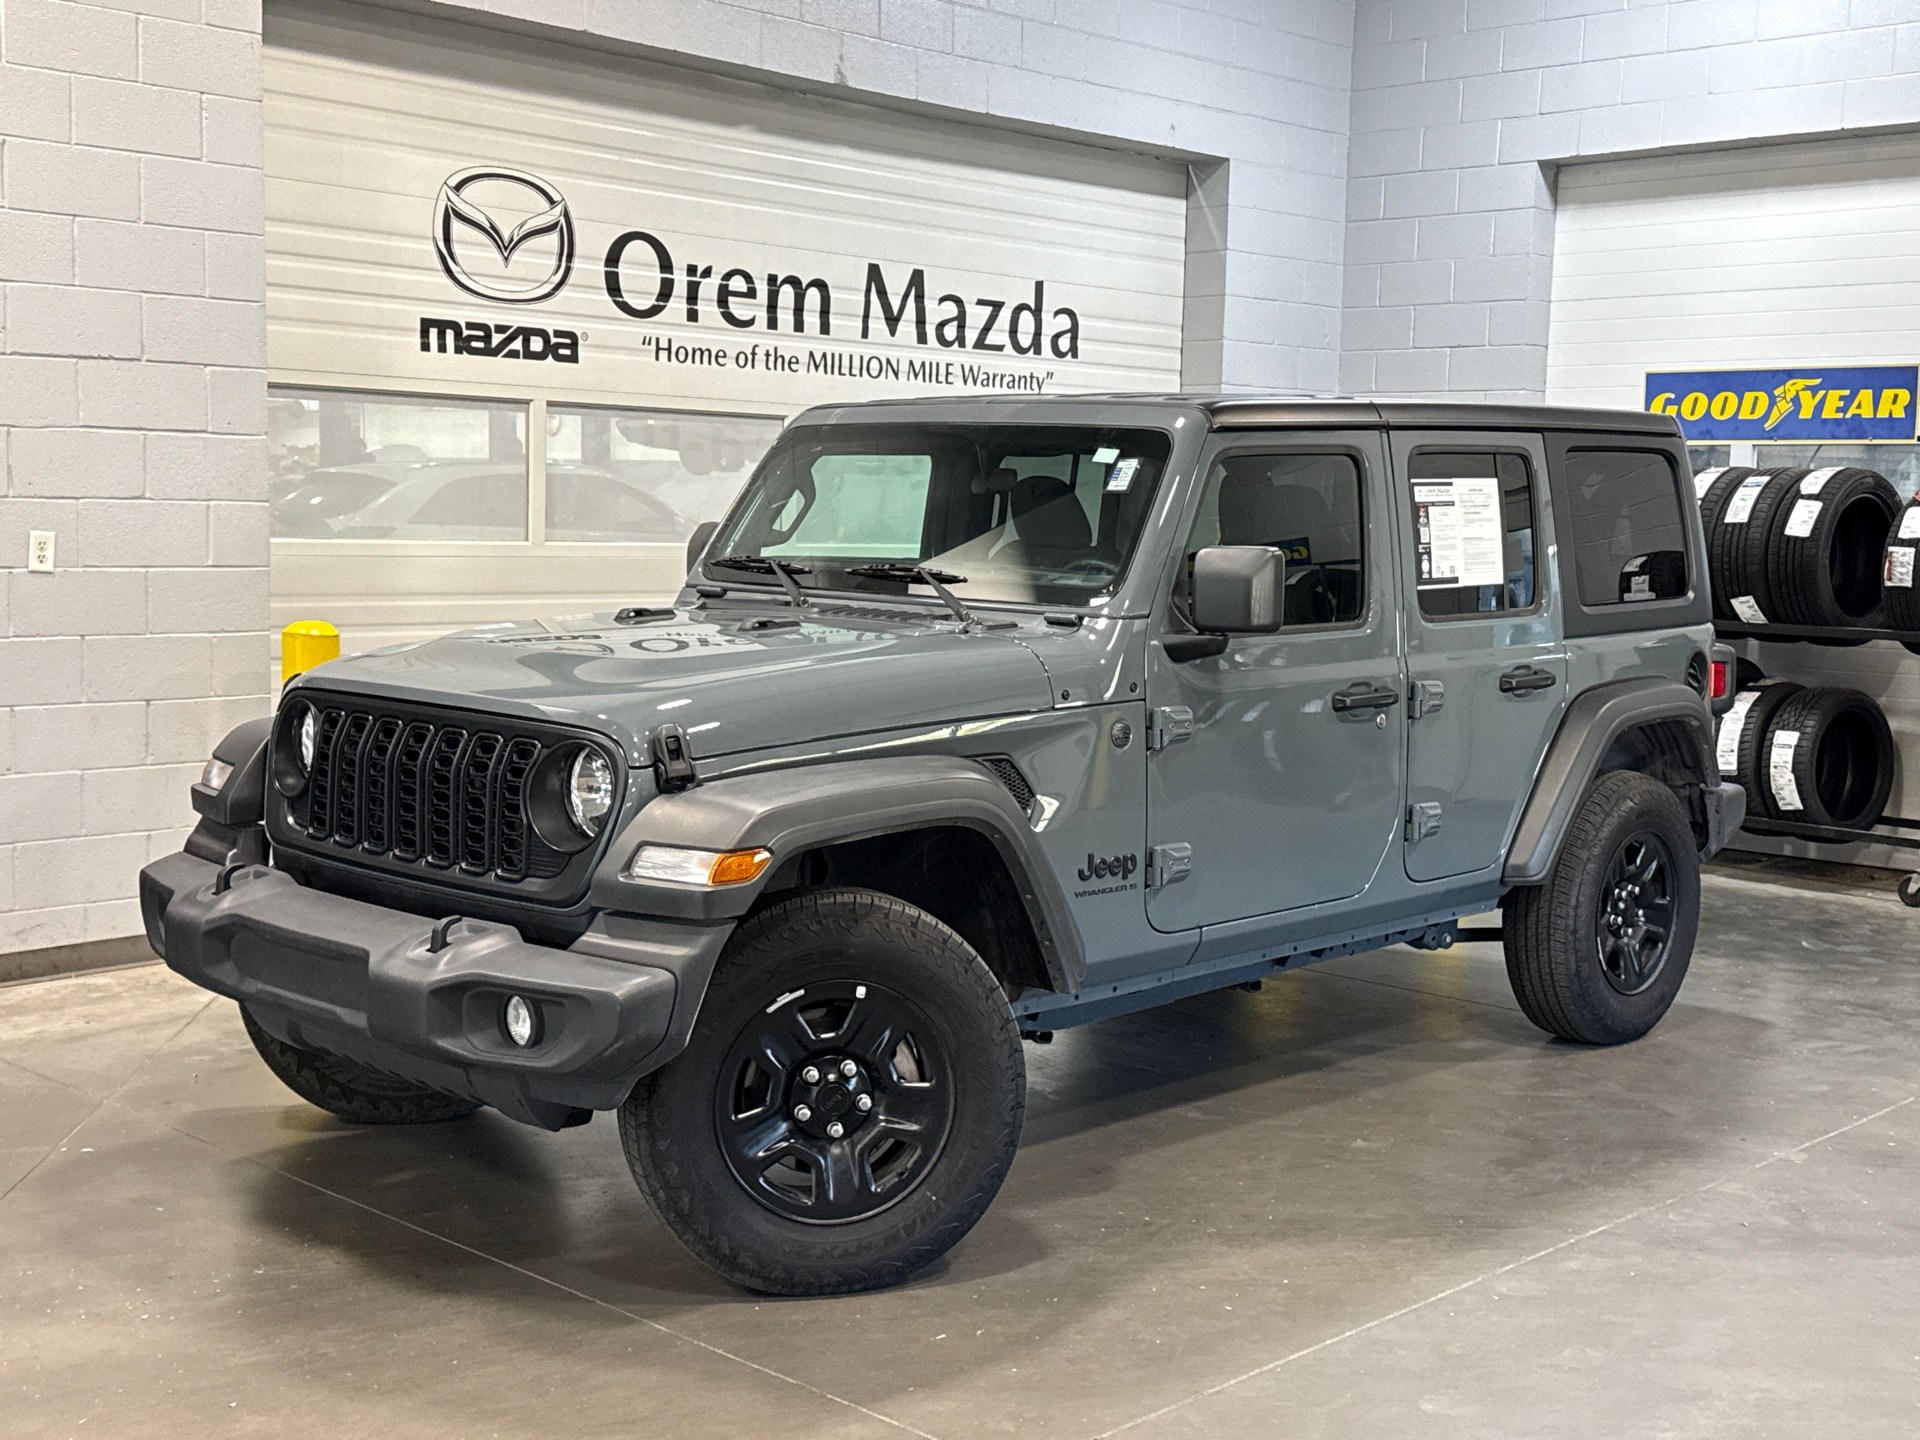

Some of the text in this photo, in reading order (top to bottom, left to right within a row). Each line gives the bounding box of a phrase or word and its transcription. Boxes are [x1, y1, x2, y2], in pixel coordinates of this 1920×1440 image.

[604, 231, 1080, 360] Orem Mazda
[735, 344, 759, 370] of
[764, 346, 800, 373] the
[807, 351, 900, 381] MILLION
[907, 359, 954, 385] MILE
[1078, 852, 1137, 881] Jeep
[1074, 884, 1128, 899] WRANGLER
